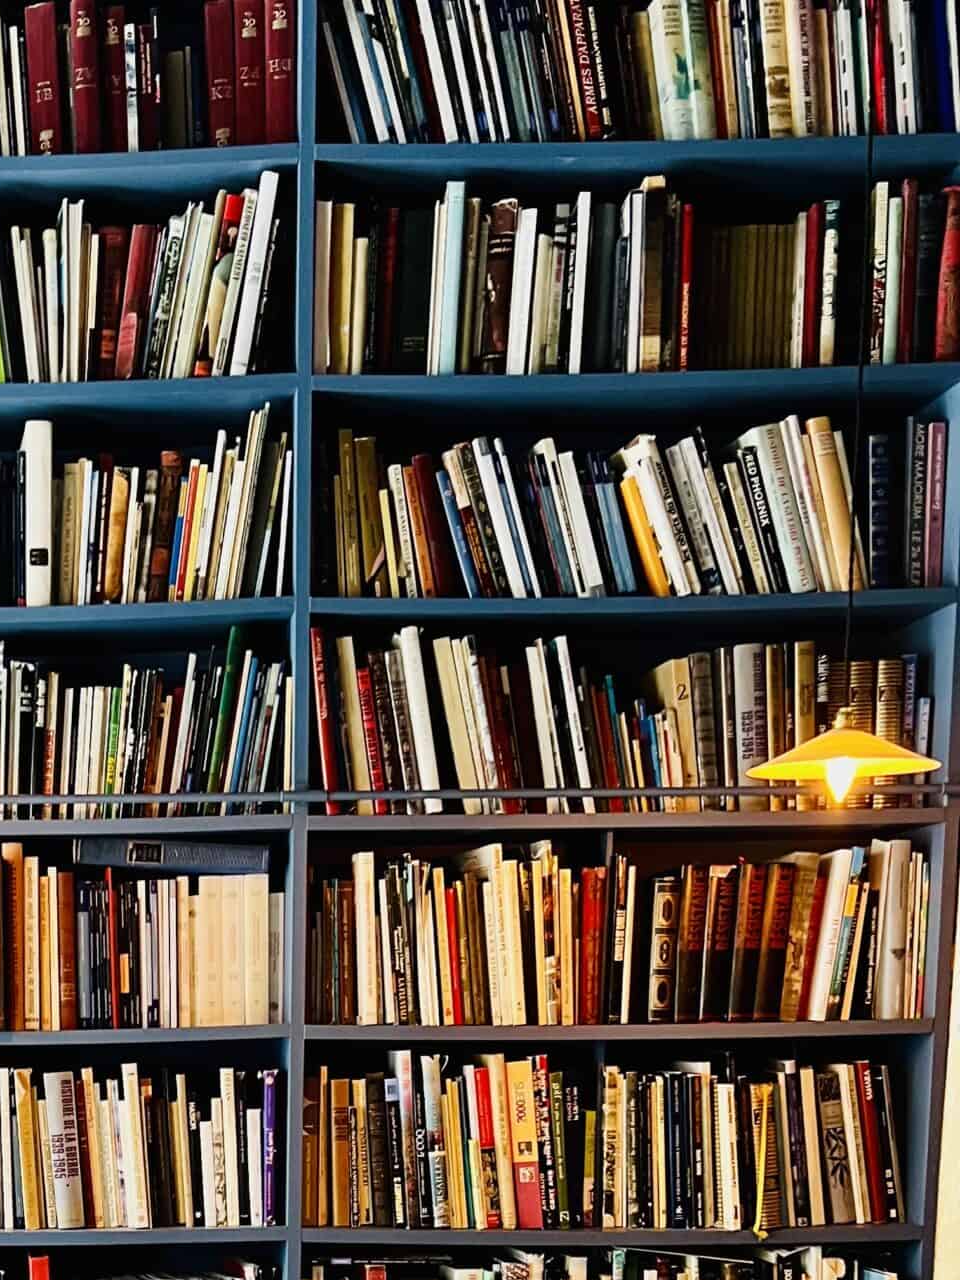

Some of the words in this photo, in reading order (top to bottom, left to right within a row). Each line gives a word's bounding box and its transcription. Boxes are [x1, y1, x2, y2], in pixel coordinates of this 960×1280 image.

[581, 68, 599, 114] ARMES
[914, 423, 925, 457] MORE
[745, 454, 757, 476] RED
[750, 477, 770, 527] PHOENIX
[741, 710, 754, 761] 1939-1945
[60, 1078, 74, 1118] HISTOIRE
[63, 1119, 75, 1130] DE
[64, 1132, 76, 1144] LA
[51, 1133, 66, 1180] 1939-1945
[65, 1145, 79, 1179] GUERRE
